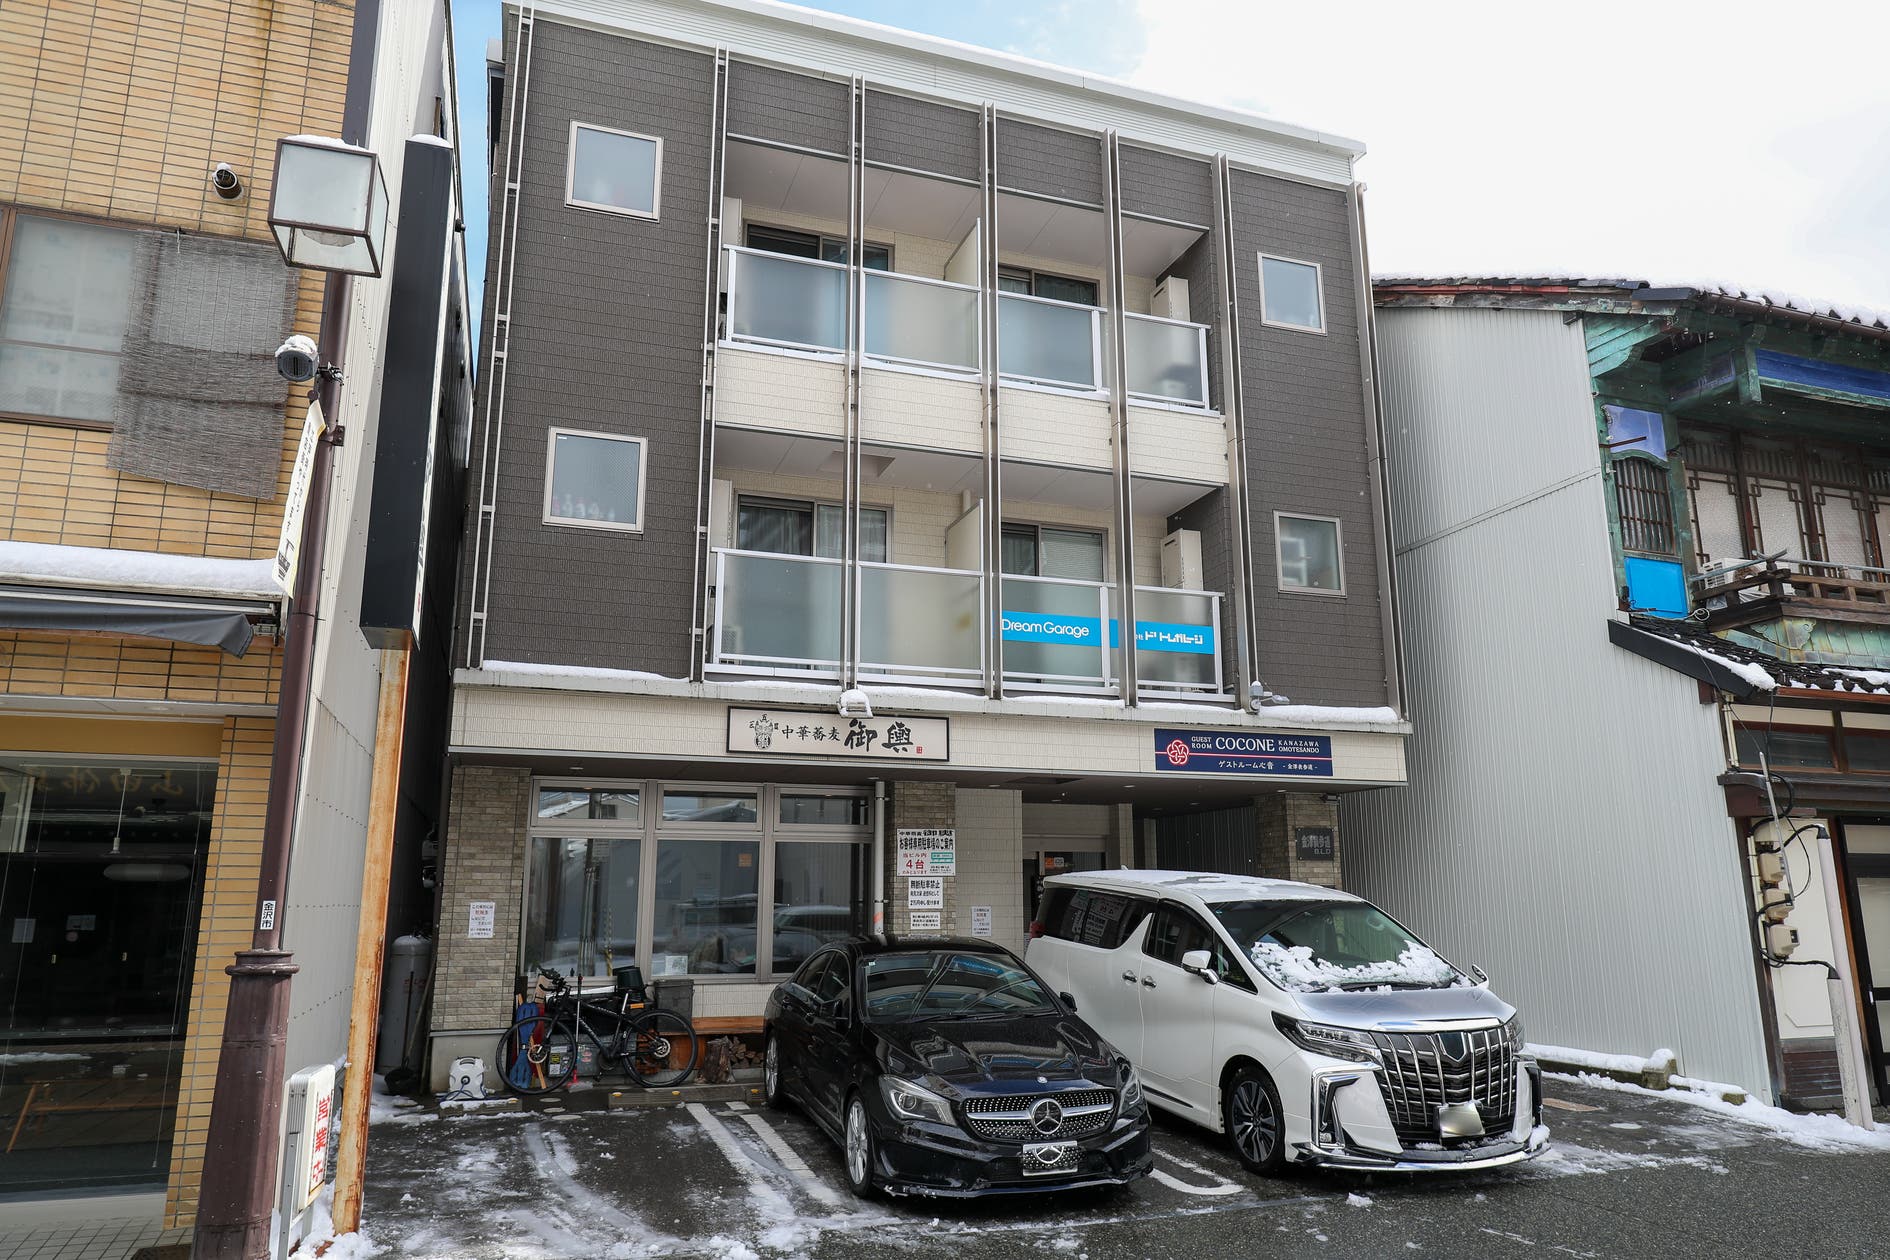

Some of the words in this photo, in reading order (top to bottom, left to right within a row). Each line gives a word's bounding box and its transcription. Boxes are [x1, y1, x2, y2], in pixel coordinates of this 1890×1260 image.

[1001, 618, 1042, 634] Dream
[1043, 621, 1090, 638] Garage
[781, 725, 840, 742] 中華蕎麦
[844, 718, 914, 753] 御輿
[1215, 737, 1275, 752] COCONE
[1278, 746, 1320, 754] OMOTESANDO
[262, 902, 274, 928] 金沢市
